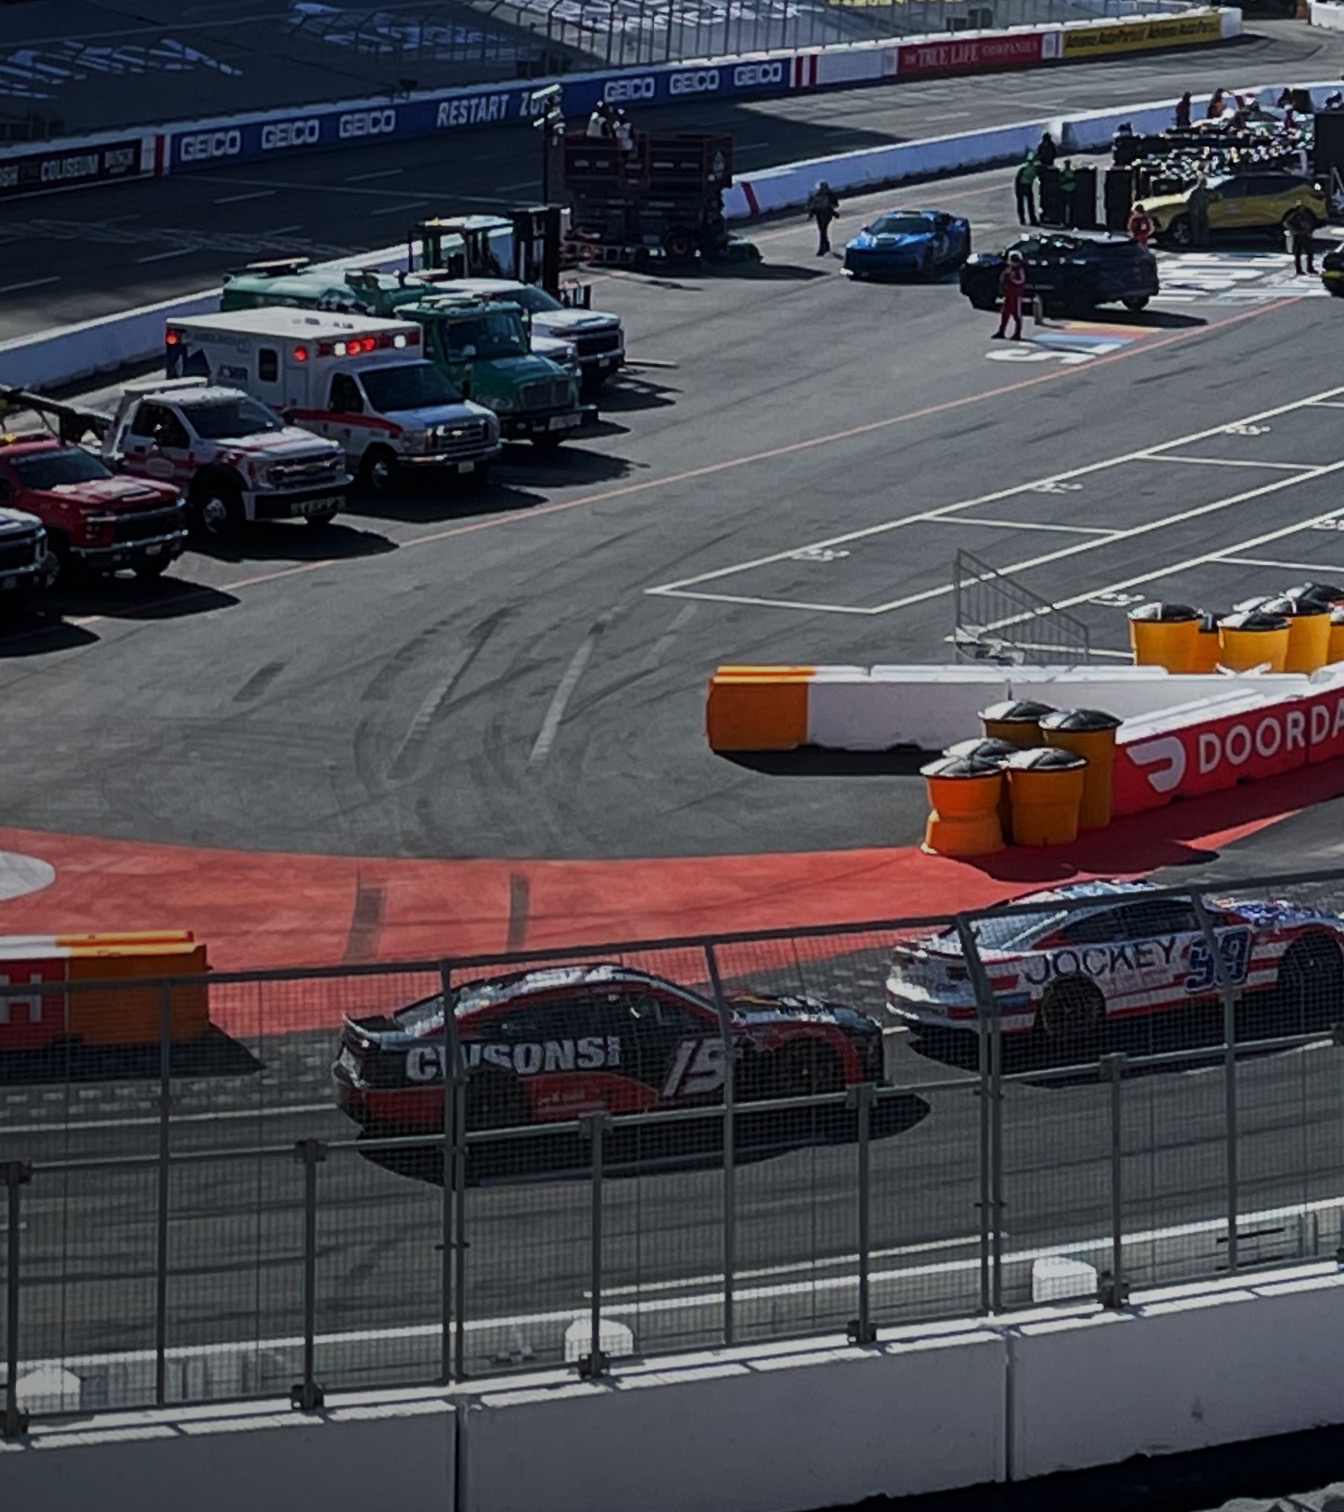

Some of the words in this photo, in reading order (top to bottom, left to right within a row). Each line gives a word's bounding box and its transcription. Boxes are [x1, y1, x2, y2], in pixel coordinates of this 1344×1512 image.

[604, 75, 656, 104] GEICO
[669, 69, 721, 95] GEICO
[733, 62, 783, 88] GEICO
[339, 108, 397, 139] GEICO
[436, 93, 511, 128] RESTART
[179, 128, 242, 162] GEICO
[261, 119, 321, 150] GEICO
[40, 153, 100, 183] COLISEUM
[1025, 936, 1178, 987] JOCKEY
[661, 1040, 731, 1097] 15
